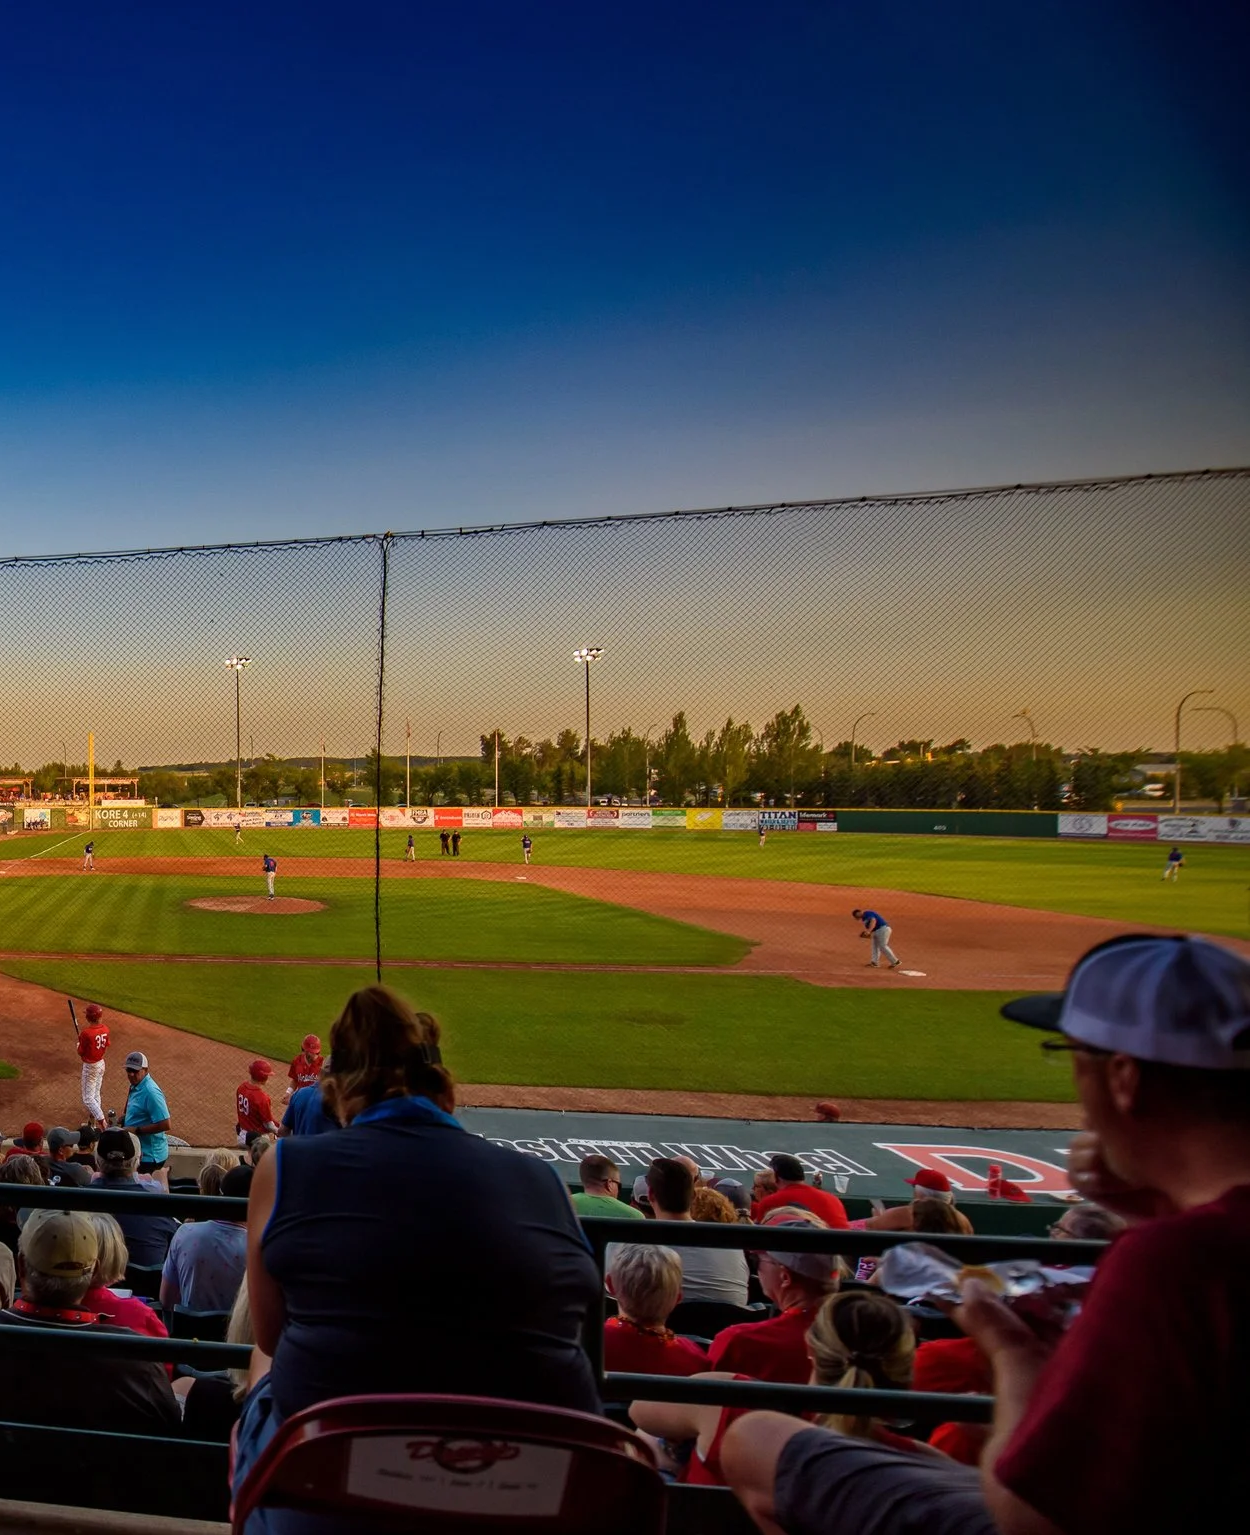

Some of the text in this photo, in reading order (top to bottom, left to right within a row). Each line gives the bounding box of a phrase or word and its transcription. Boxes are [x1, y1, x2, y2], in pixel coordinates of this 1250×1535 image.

[95, 810, 146, 819] KORE 4 (+14)
[760, 811, 797, 819] TITAN
[108, 820, 138, 828] CORNER
[95, 1033, 108, 1050] 35
[238, 1093, 249, 1116] 29
